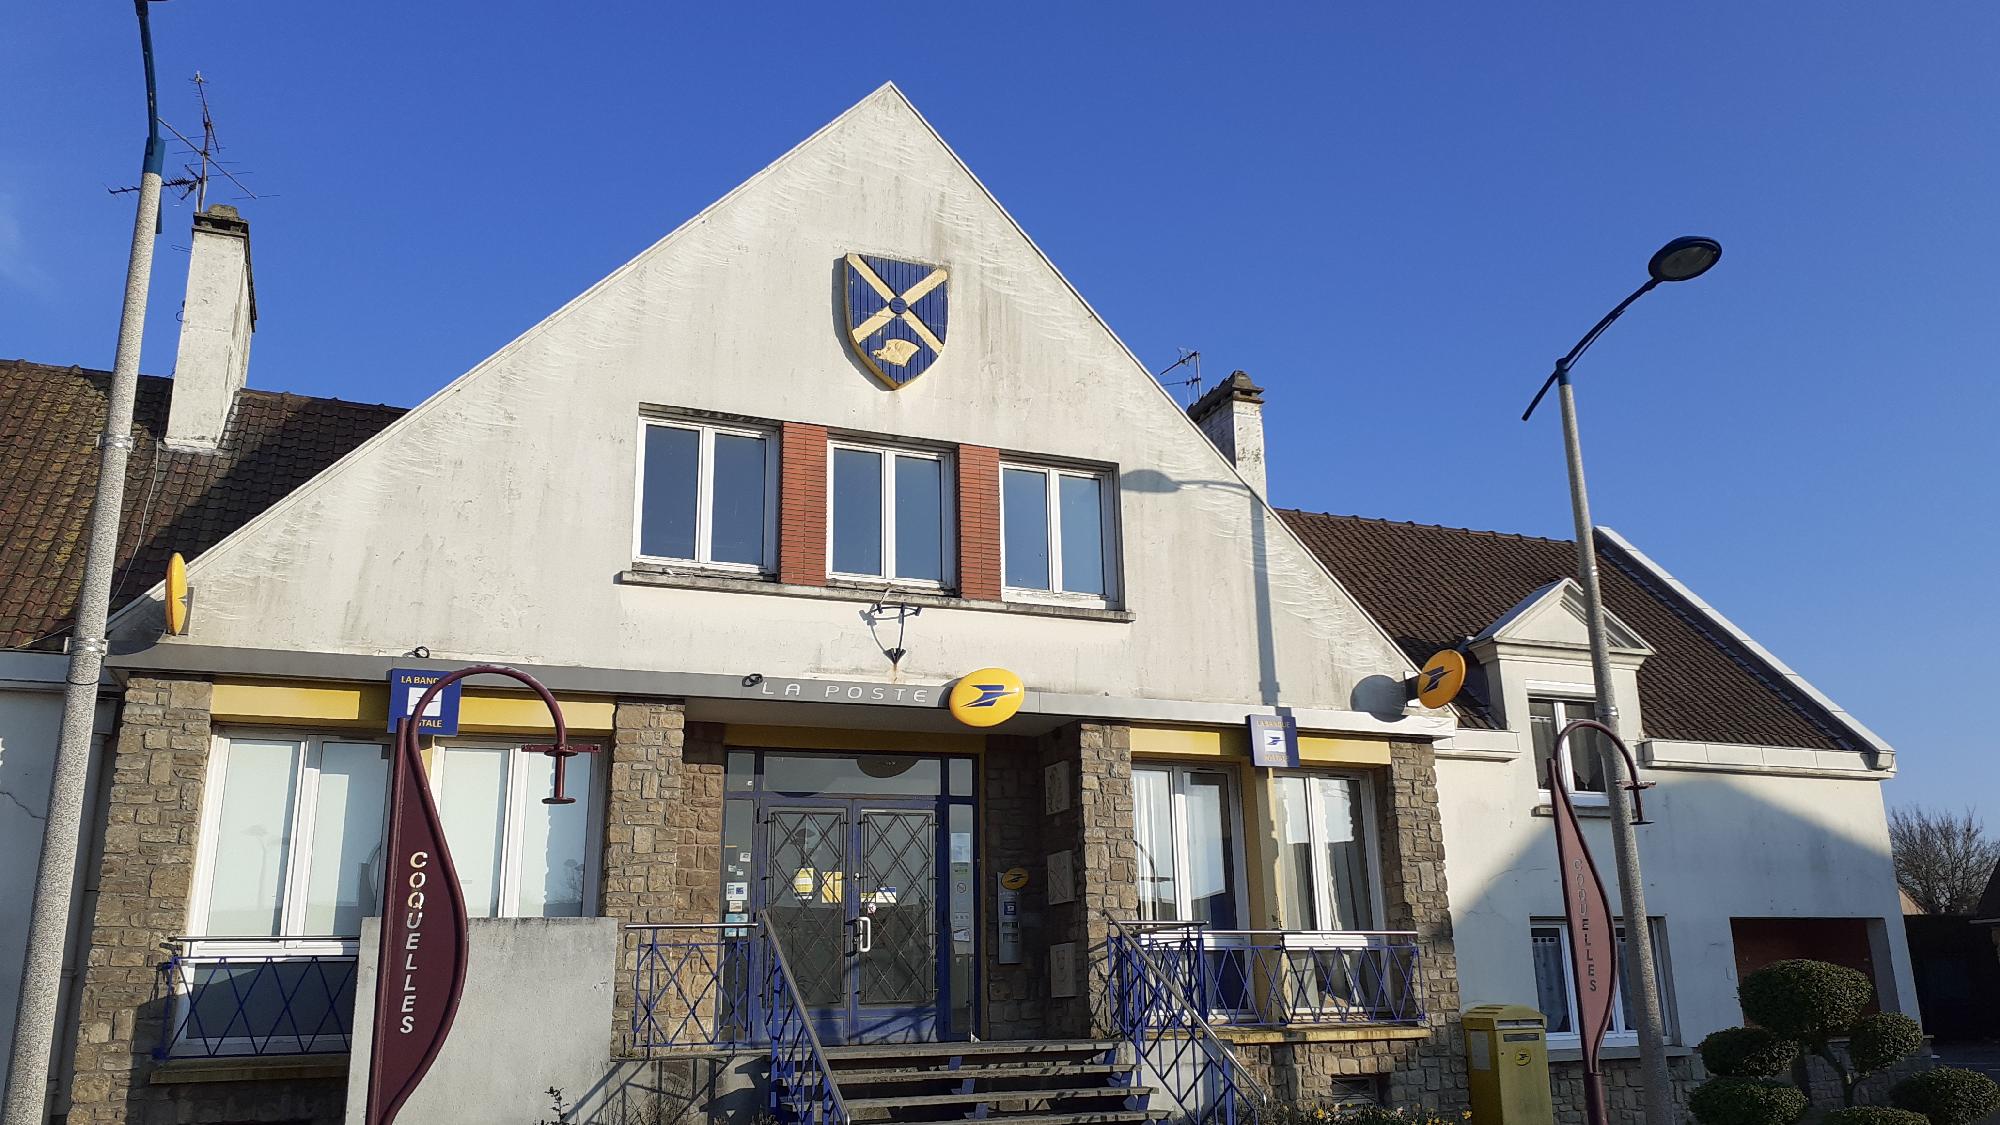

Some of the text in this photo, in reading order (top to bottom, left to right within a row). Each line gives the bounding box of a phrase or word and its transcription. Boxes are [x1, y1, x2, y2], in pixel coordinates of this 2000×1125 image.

[401, 675, 412, 684] LA
[762, 682, 928, 703] LA POSTE
[400, 851, 428, 1034] COQUELLES
[1574, 858, 1597, 992] COQUELLES
